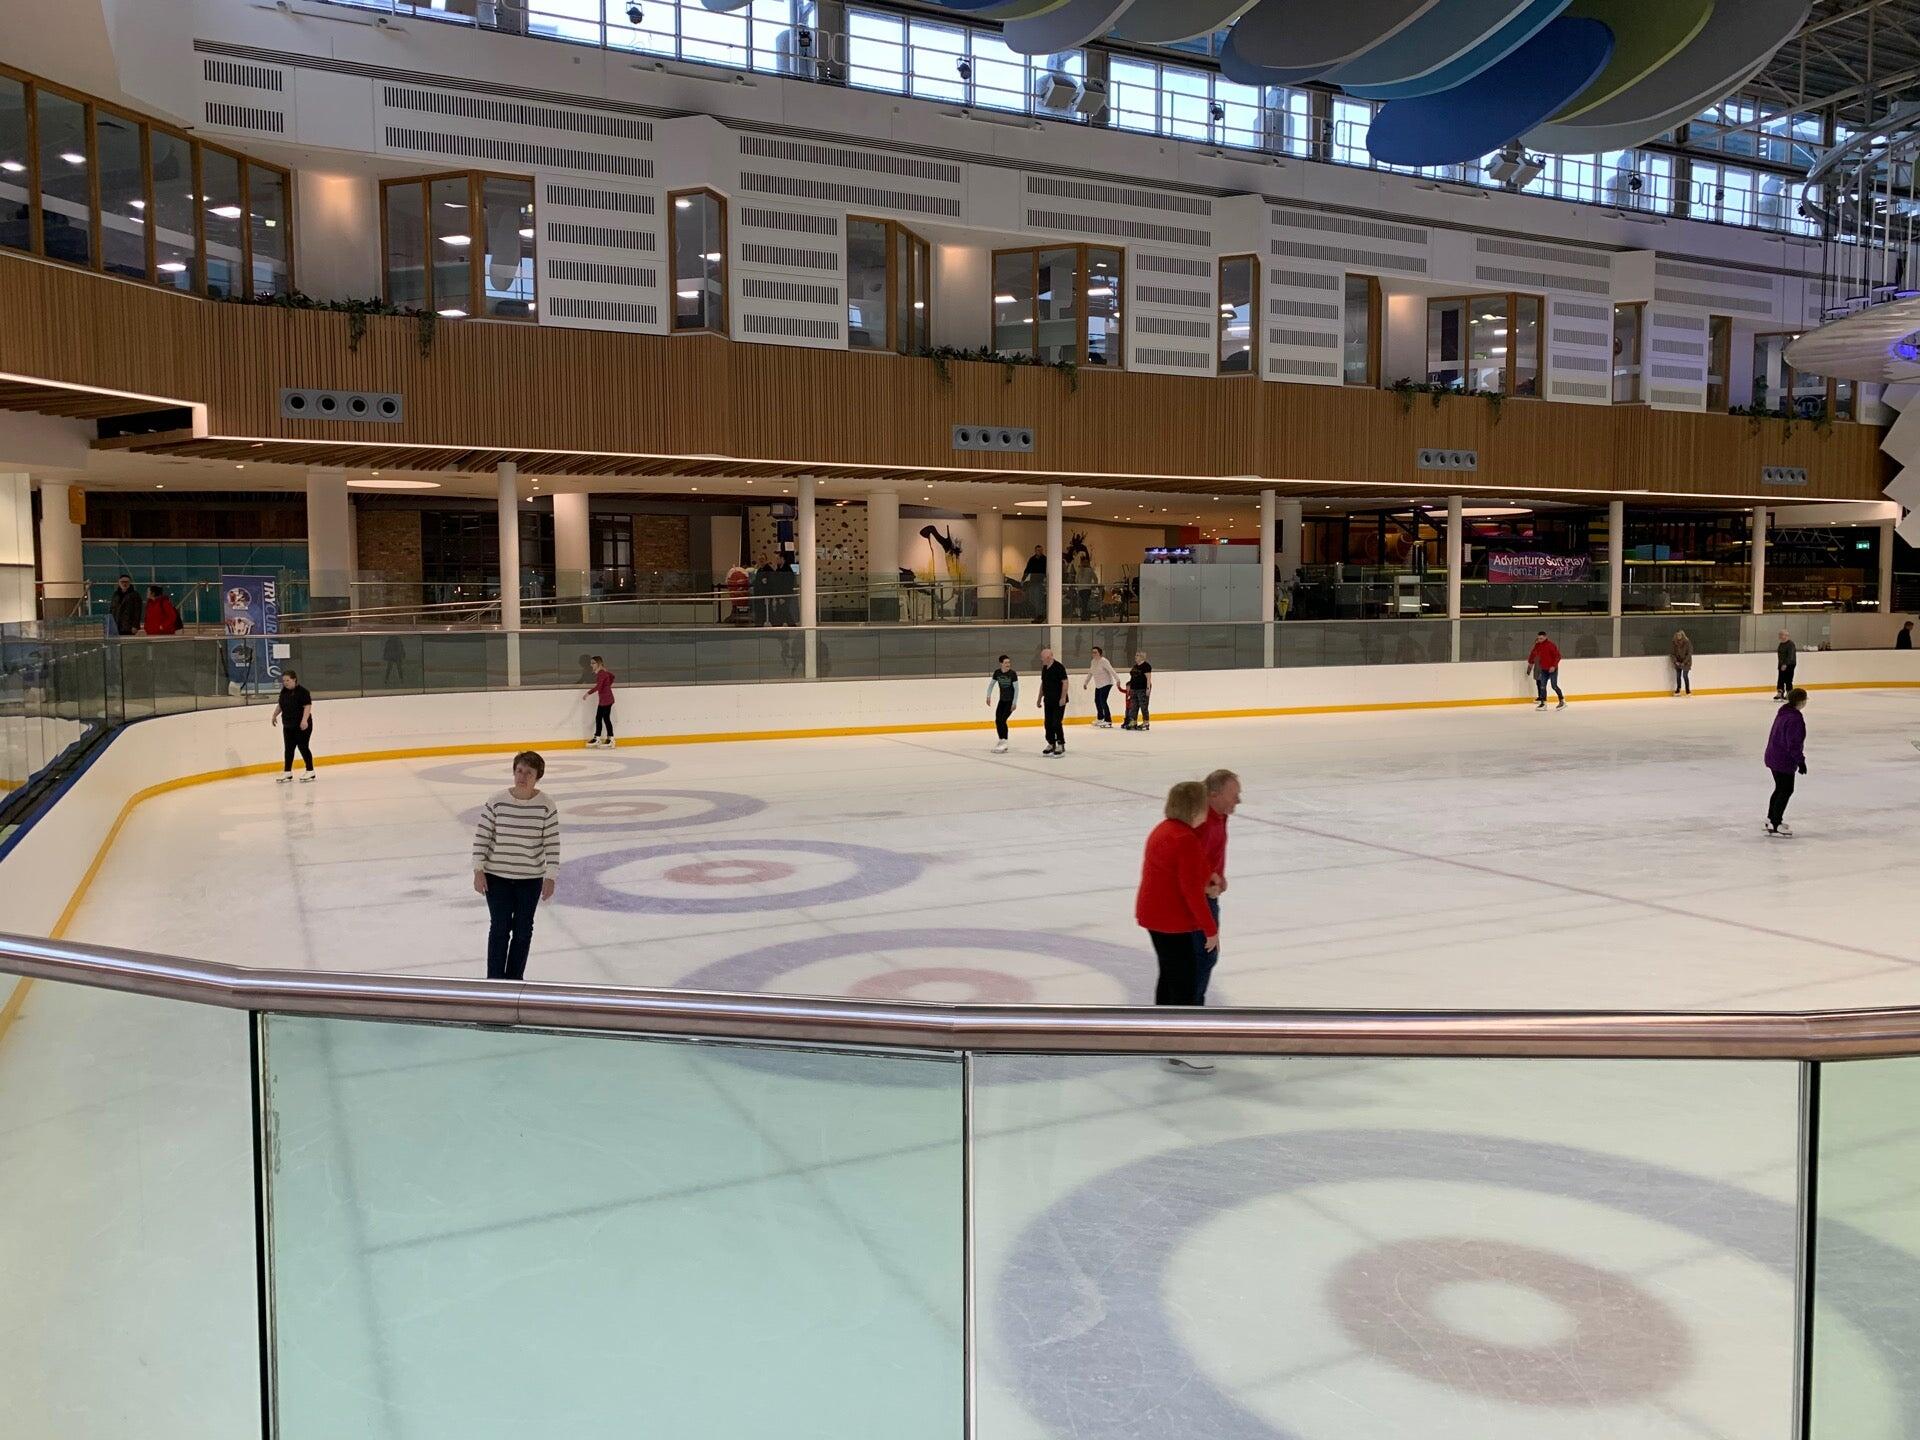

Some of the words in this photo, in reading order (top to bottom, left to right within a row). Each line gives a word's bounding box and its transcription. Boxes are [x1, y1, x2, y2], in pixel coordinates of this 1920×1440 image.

[815, 547, 857, 561] RIAL
[1493, 555, 1545, 566] Adventure
[1545, 555, 1564, 567] Soft
[1508, 566, 1528, 576] from
[1540, 567, 1554, 577] per
